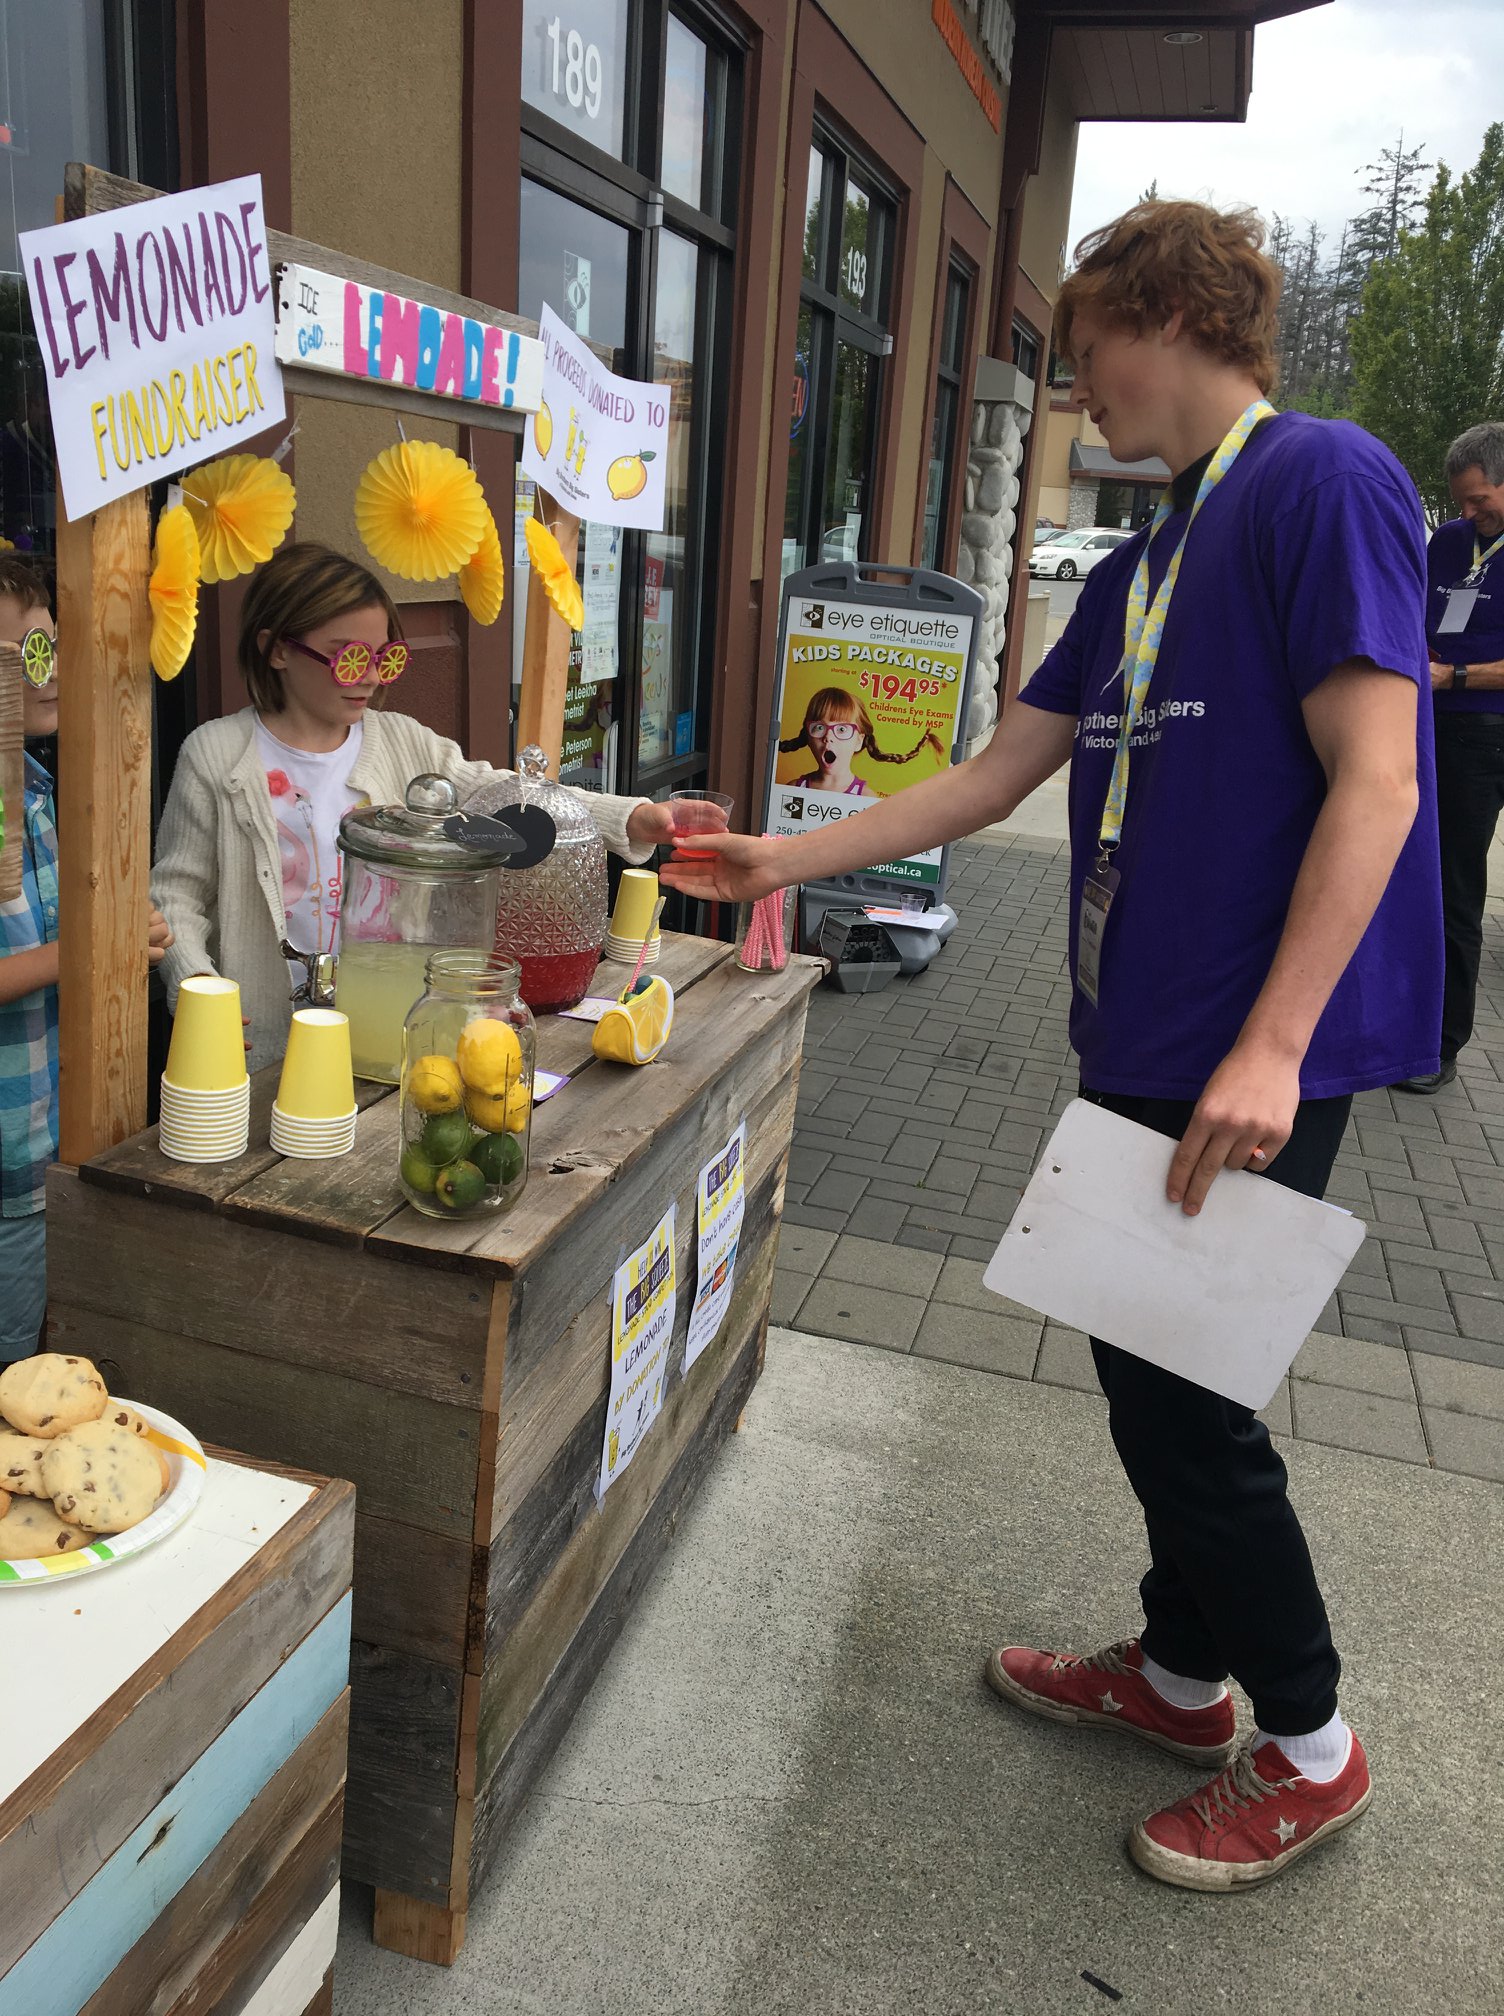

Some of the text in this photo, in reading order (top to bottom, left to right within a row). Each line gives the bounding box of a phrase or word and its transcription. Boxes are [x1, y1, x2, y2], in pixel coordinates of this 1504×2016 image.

[547, 15, 602, 119] 189
[33, 201, 271, 380] LEMONADE
[847, 246, 867, 299] 193
[297, 281, 319, 316] ICE
[552, 340, 587, 398] PROCEEDS
[588, 377, 635, 424] DONATED
[646, 400, 665, 429] TO
[90, 341, 265, 480] FUNDRAISER
[828, 611, 960, 640] eye etiquette
[869, 633, 956, 649] OPTICAL BOUTIQUE
[792, 644, 959, 683] KIDS PACKAGES
[869, 701, 954, 721] Childrens Eye Exams
[876, 713, 944, 729] Covered by MSP
[565, 736, 593, 755] Peterson
[807, 803, 842, 822] eye
[627, 1292, 638, 1319] THE
[640, 1275, 650, 1305] BIG
[625, 1308, 668, 1374] LEMONADE
[626, 1347, 662, 1404] DONATION
